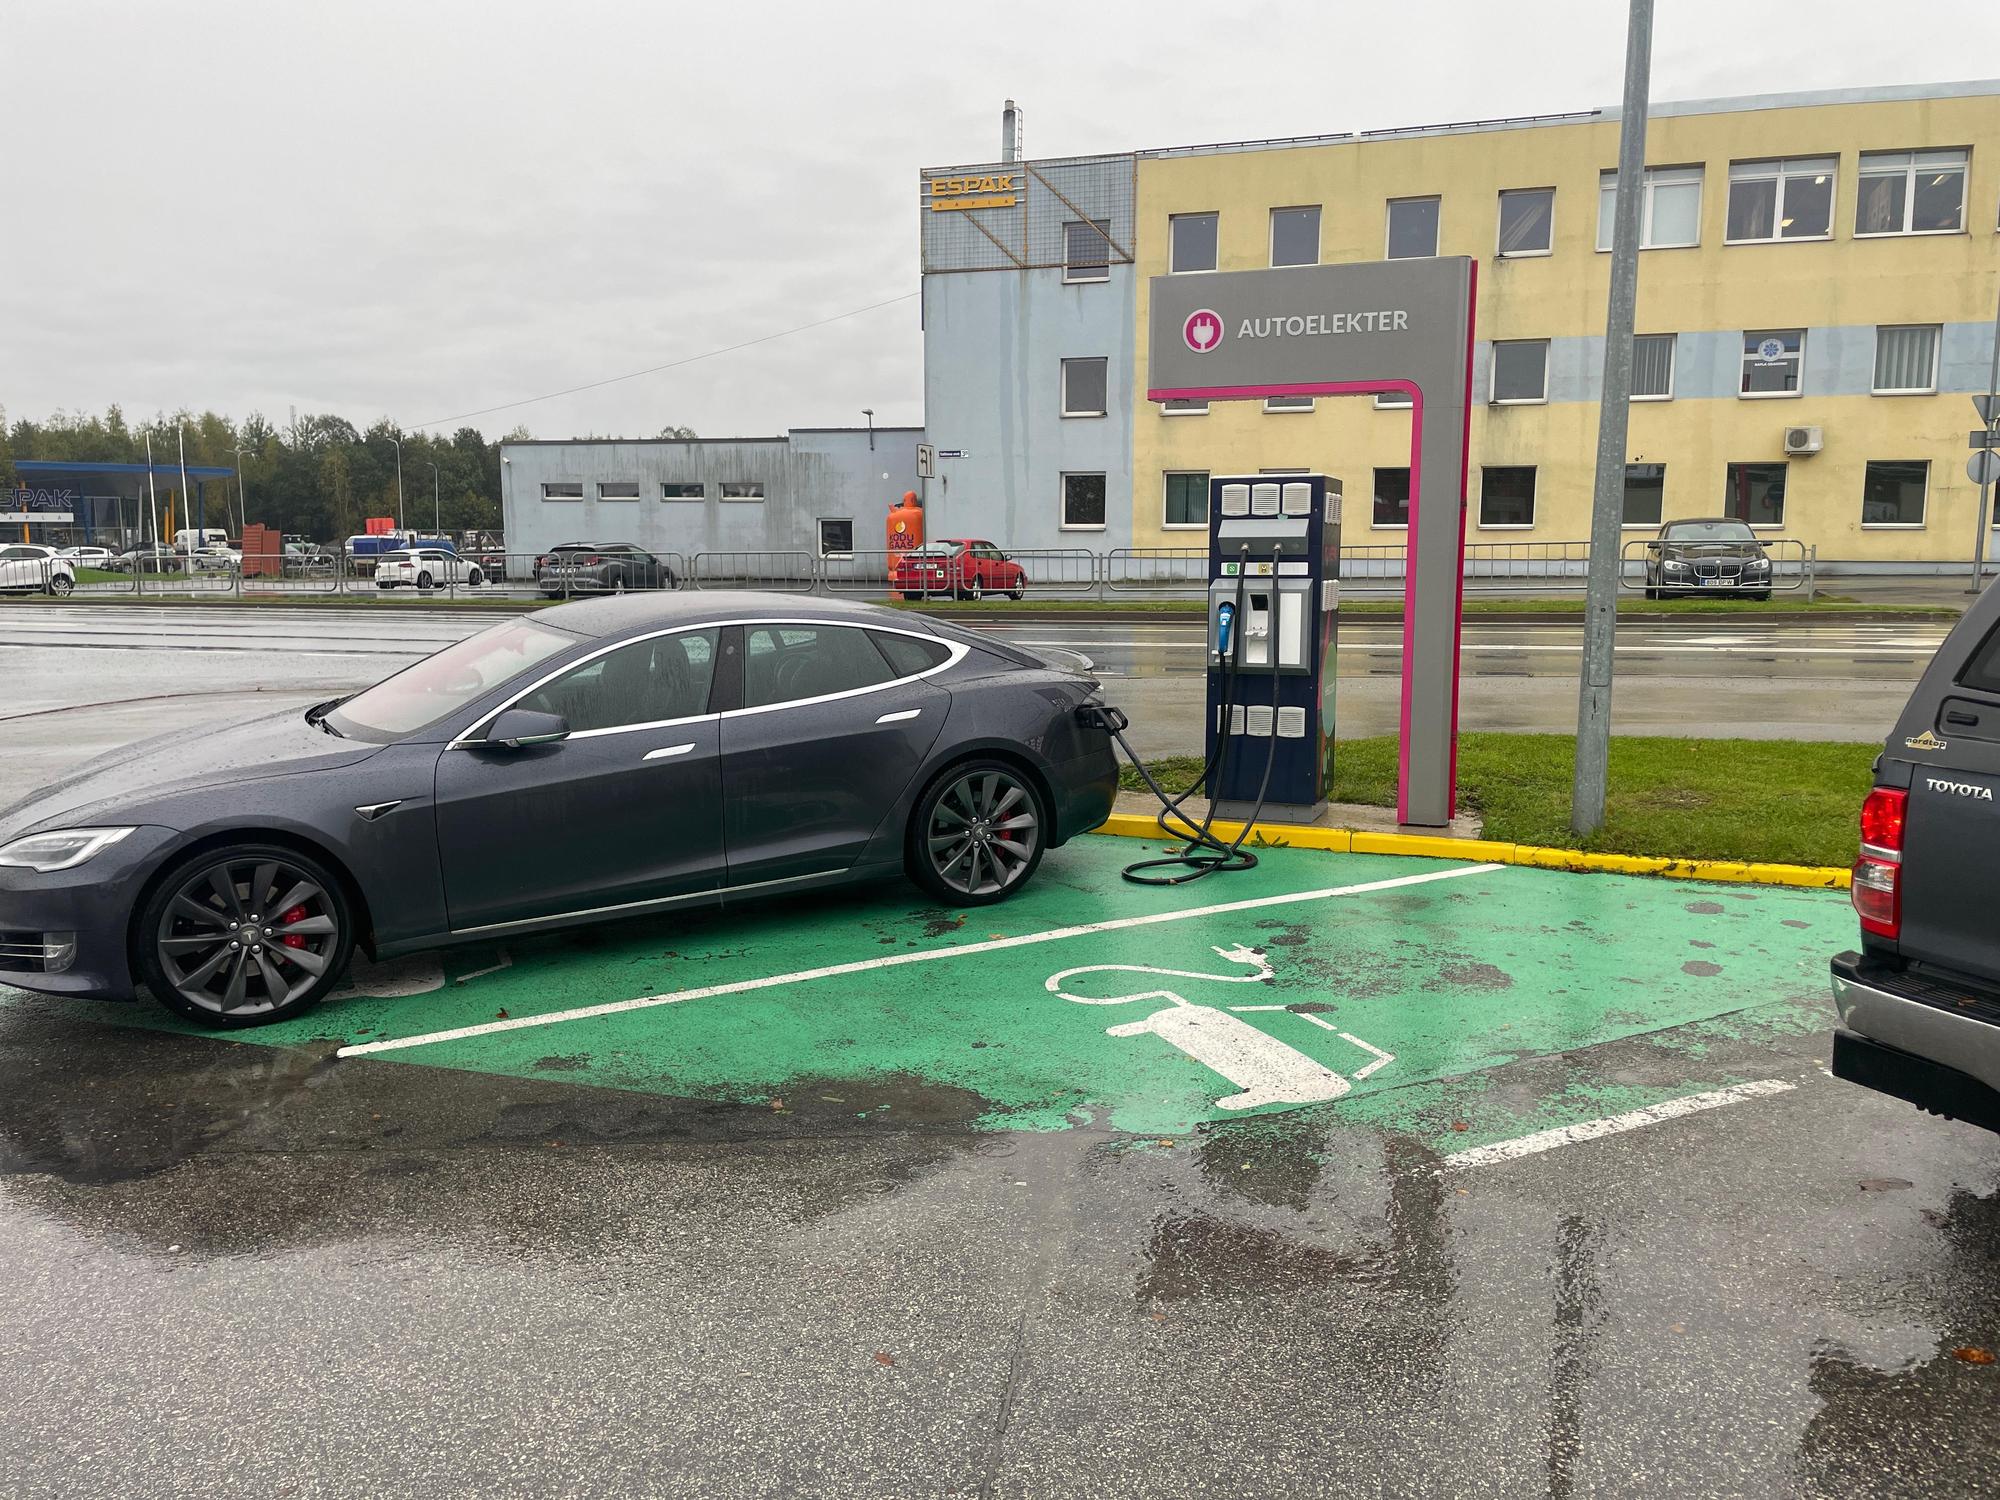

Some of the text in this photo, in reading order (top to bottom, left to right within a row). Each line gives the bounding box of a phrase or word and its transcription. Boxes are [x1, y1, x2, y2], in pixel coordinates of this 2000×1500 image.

[931, 175, 1014, 196] ESPAK
[1237, 310, 1409, 339] AUTOELEKTER
[889, 541, 915, 549] GAAS
[1906, 737, 1946, 748] nordtop
[1926, 778, 1993, 801] TOYOTA
